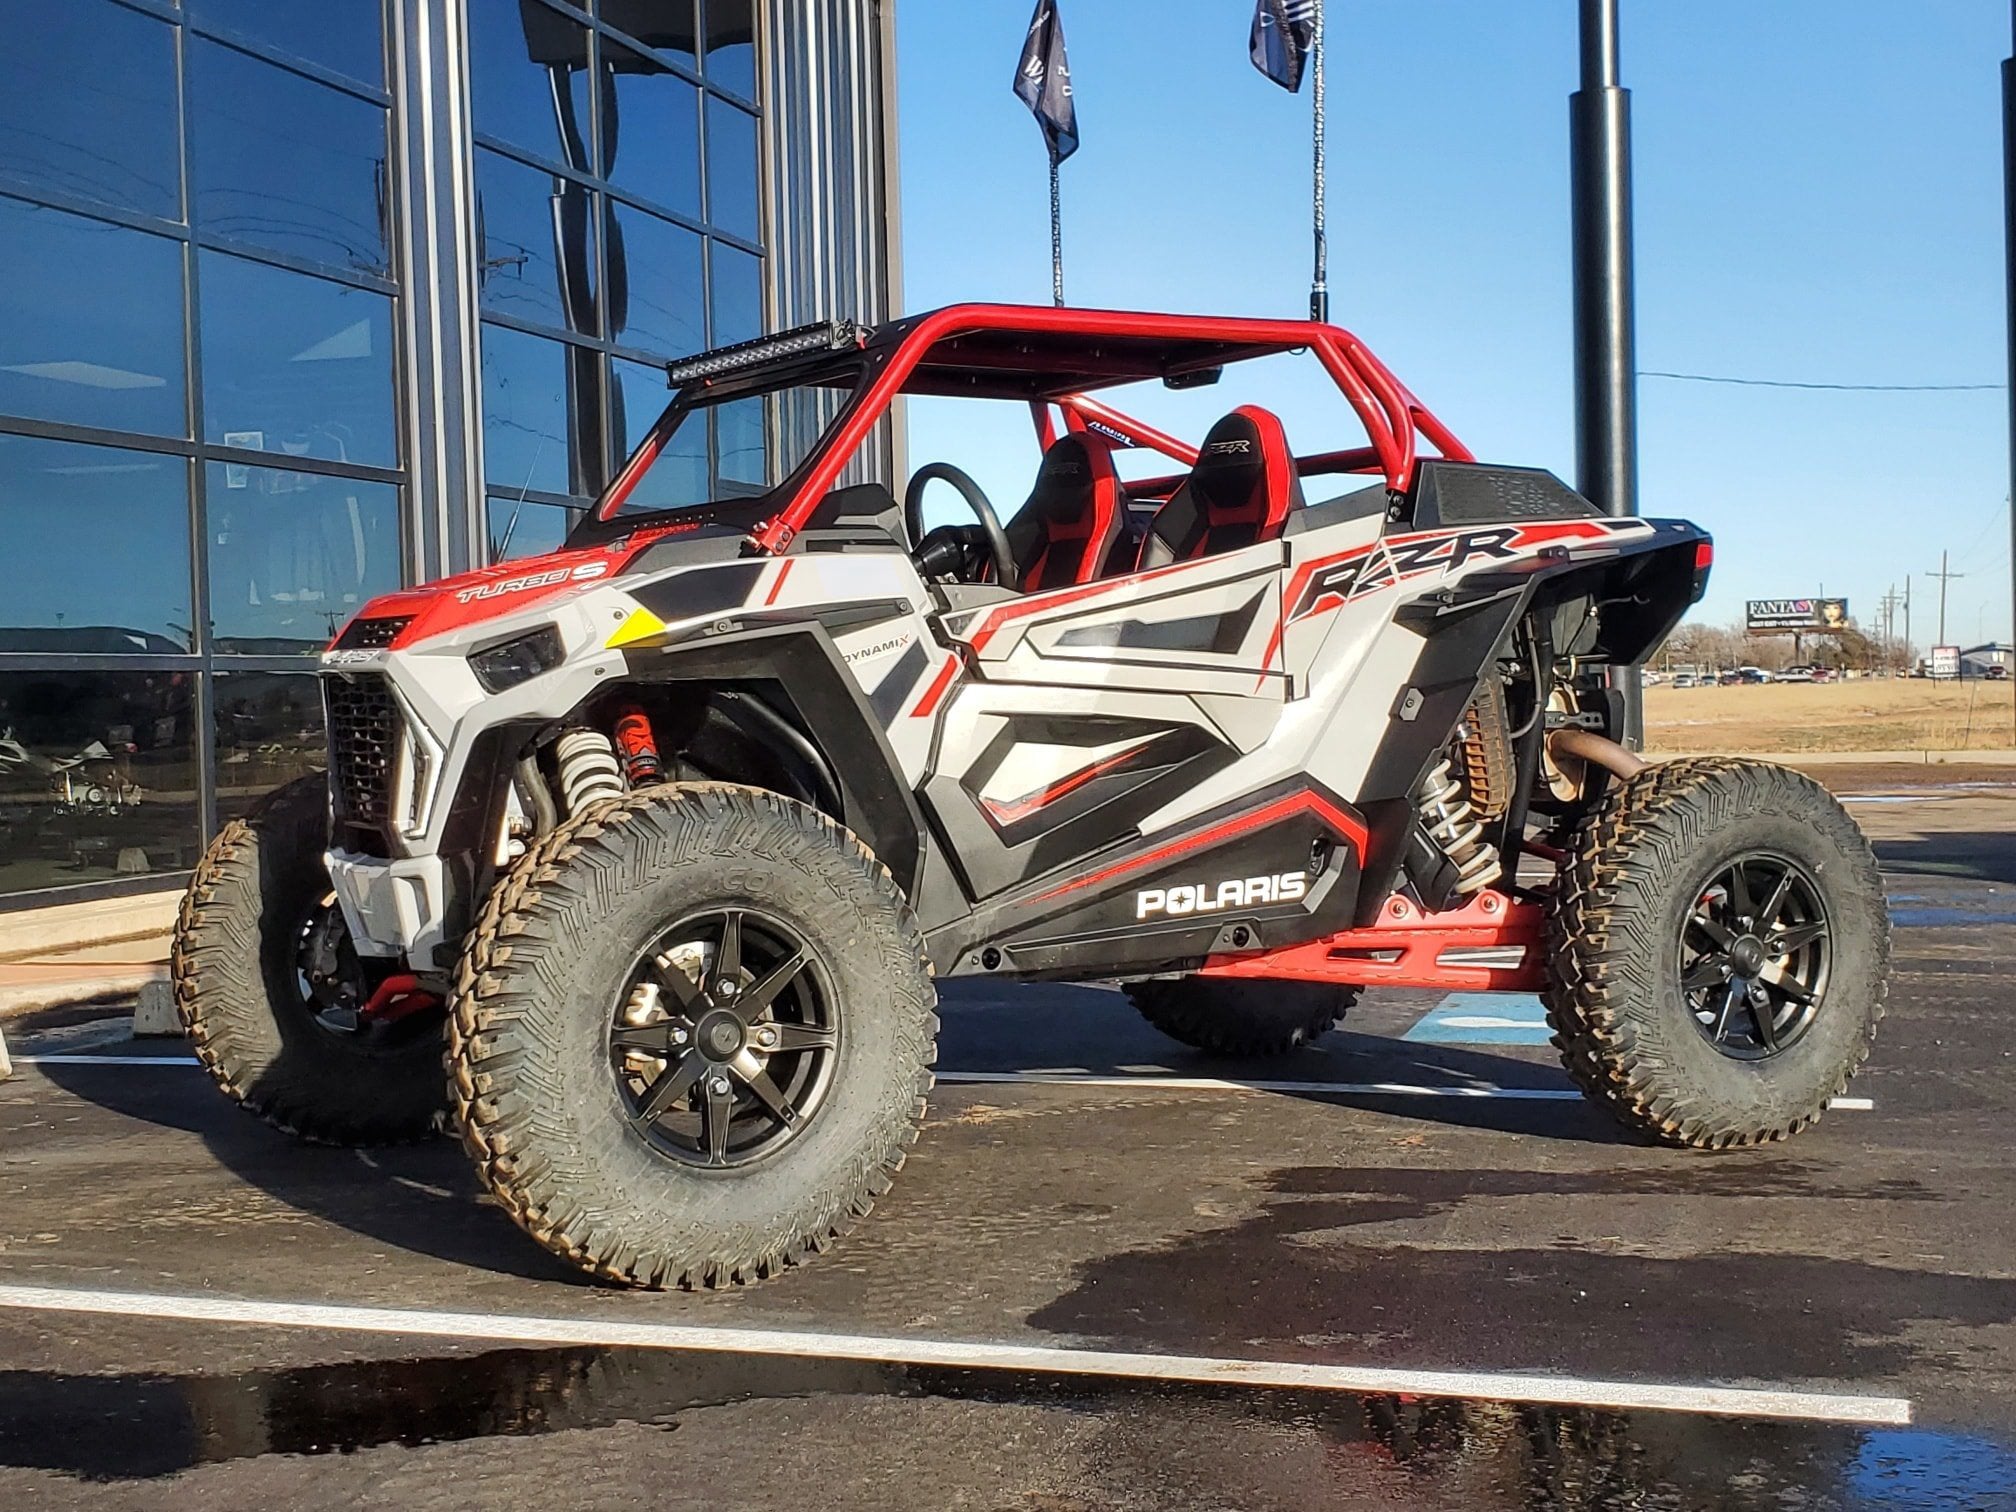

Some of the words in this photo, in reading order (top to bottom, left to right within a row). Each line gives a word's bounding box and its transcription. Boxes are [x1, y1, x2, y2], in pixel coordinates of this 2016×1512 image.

[456, 567, 571, 604] TURBO
[571, 561, 609, 581] S
[1284, 524, 1526, 627] RZR
[843, 633, 909, 663] DYNAMIX
[1136, 871, 1306, 919] POLARIS
